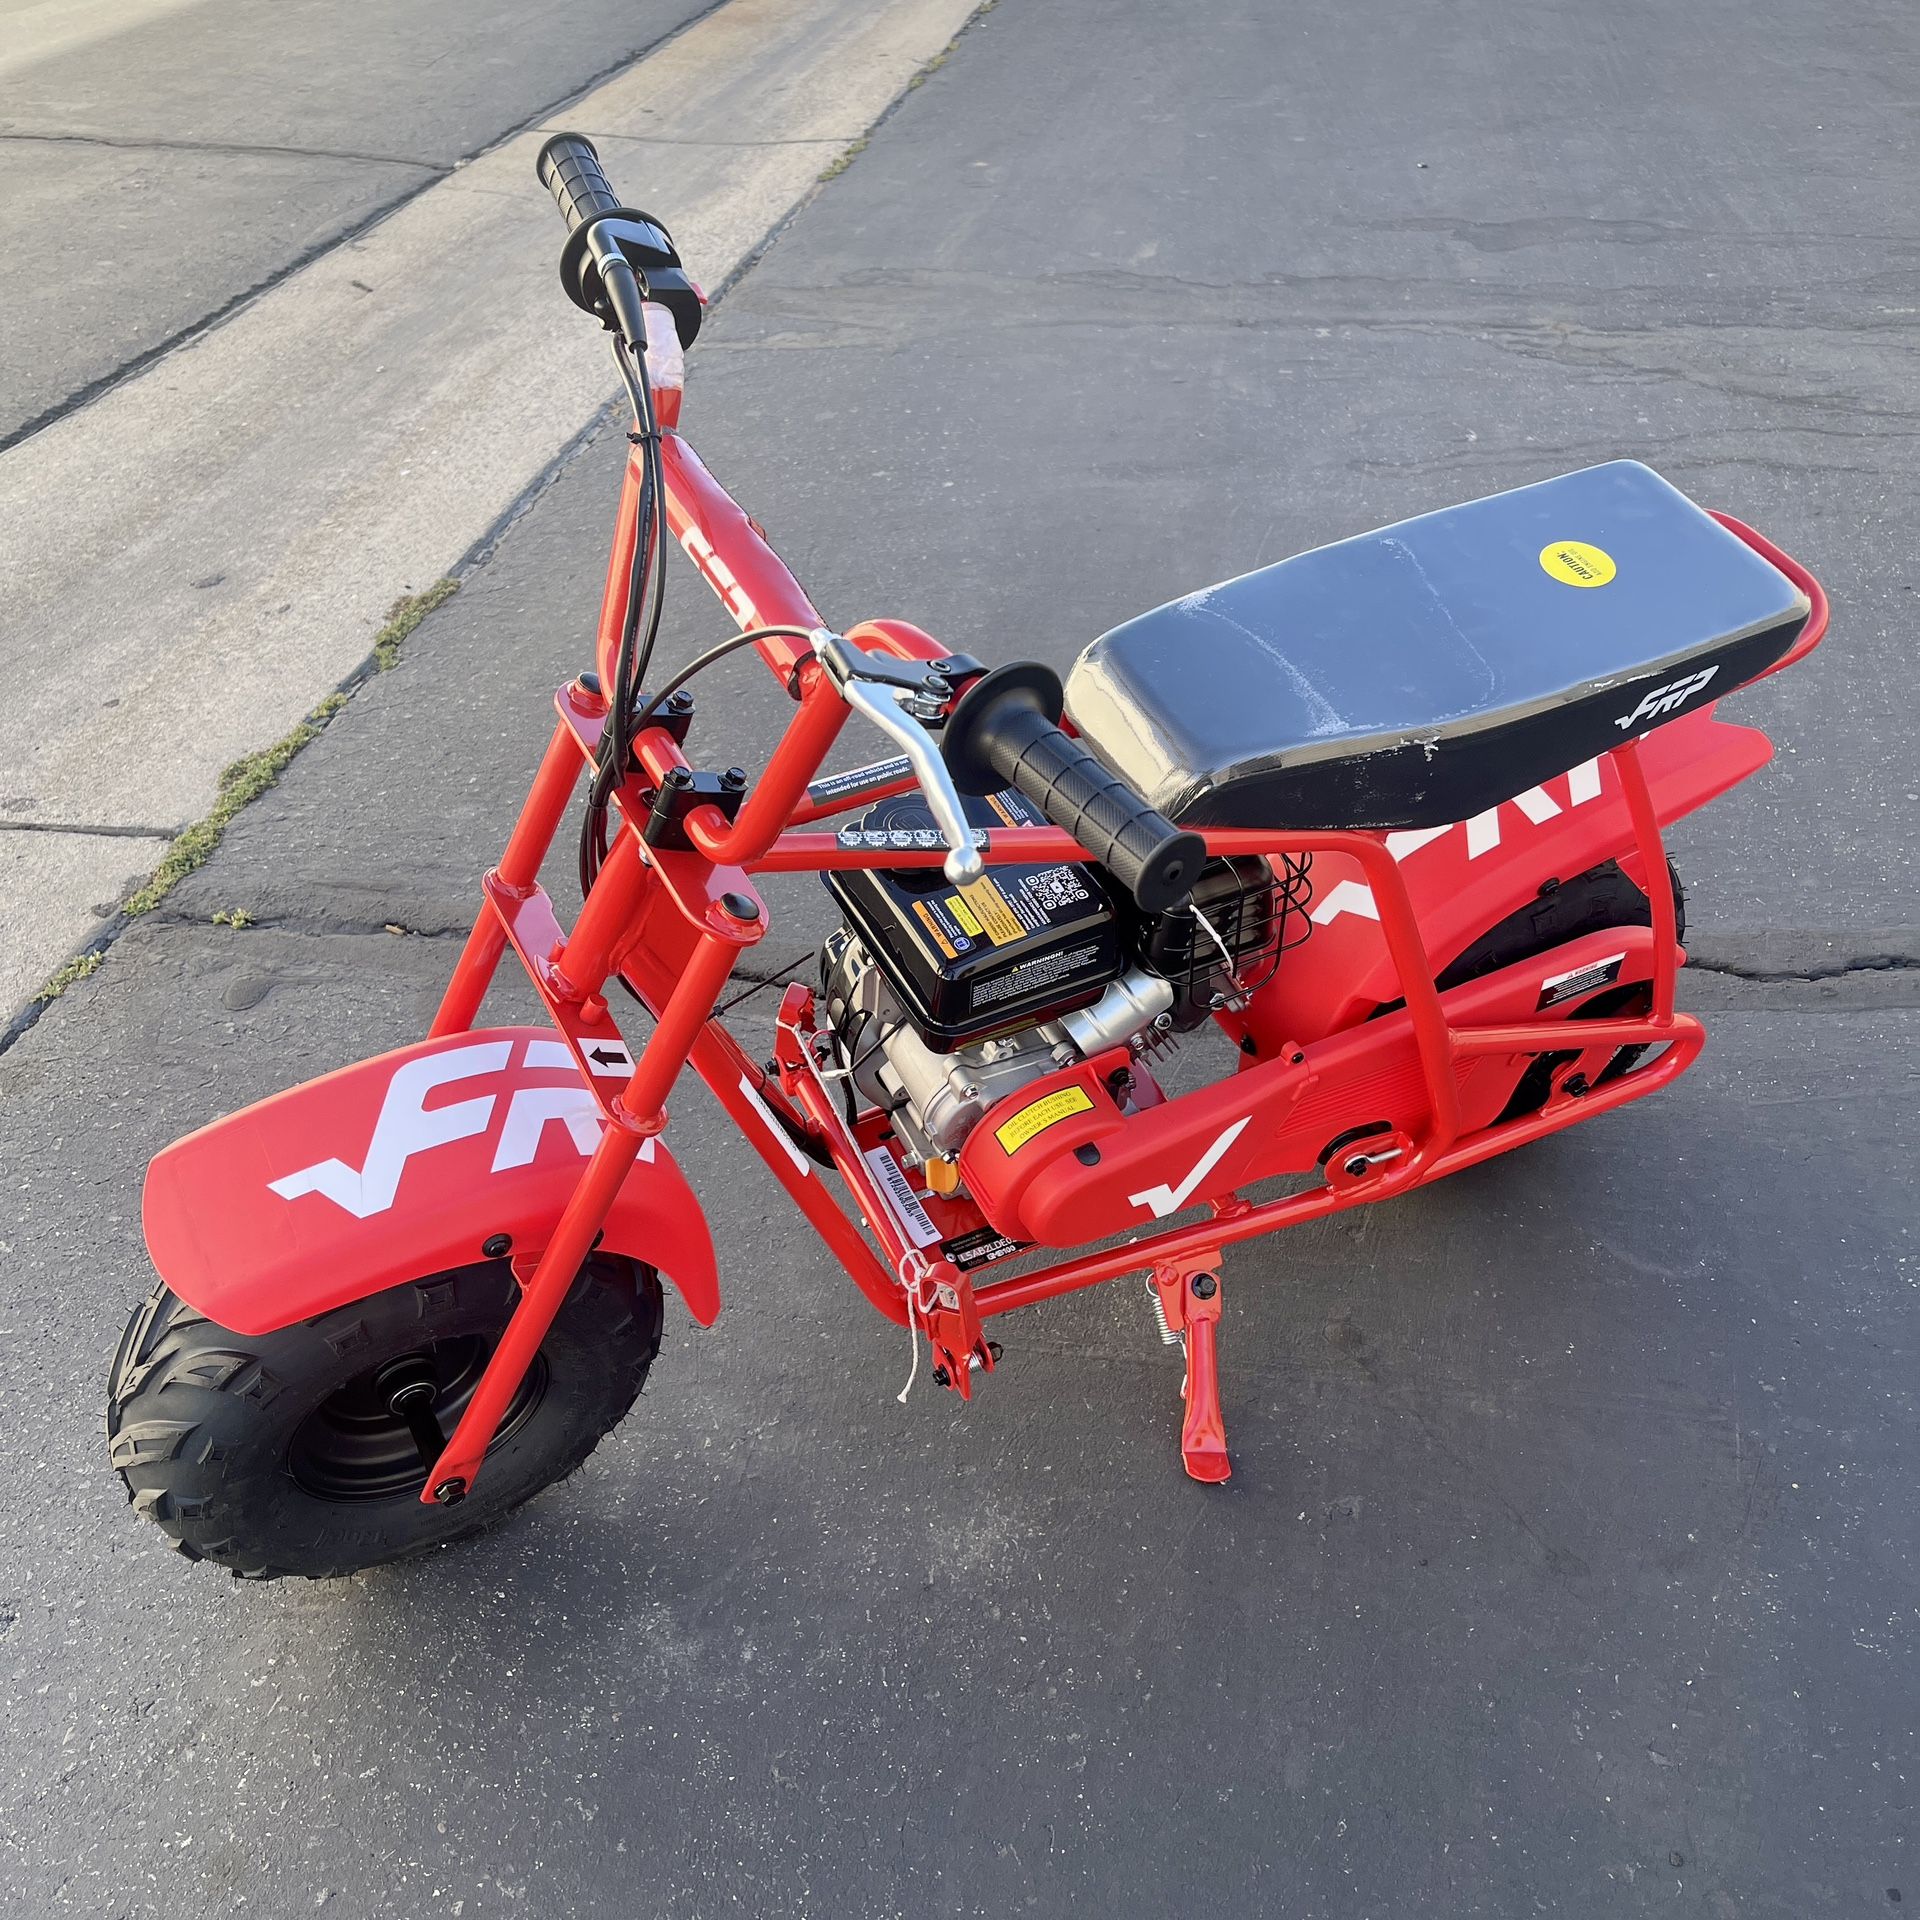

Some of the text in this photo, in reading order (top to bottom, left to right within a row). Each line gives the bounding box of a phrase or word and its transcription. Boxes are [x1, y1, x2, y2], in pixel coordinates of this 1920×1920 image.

[843, 771, 865, 782] off-road
[865, 766, 884, 776] vehicle
[884, 762, 894, 770] and
[851, 780, 859, 789] for
[859, 778, 869, 786] use
[877, 770, 893, 781] public
[924, 912, 941, 937] WARNING
[1007, 1091, 1071, 1130] OIL CLUTCH BUSHING
[1033, 1107, 1050, 1121] EACH
[1065, 1096, 1077, 1105] SEE
[1048, 1105, 1074, 1120] MANUAL
[266, 1040, 655, 1218] FR
